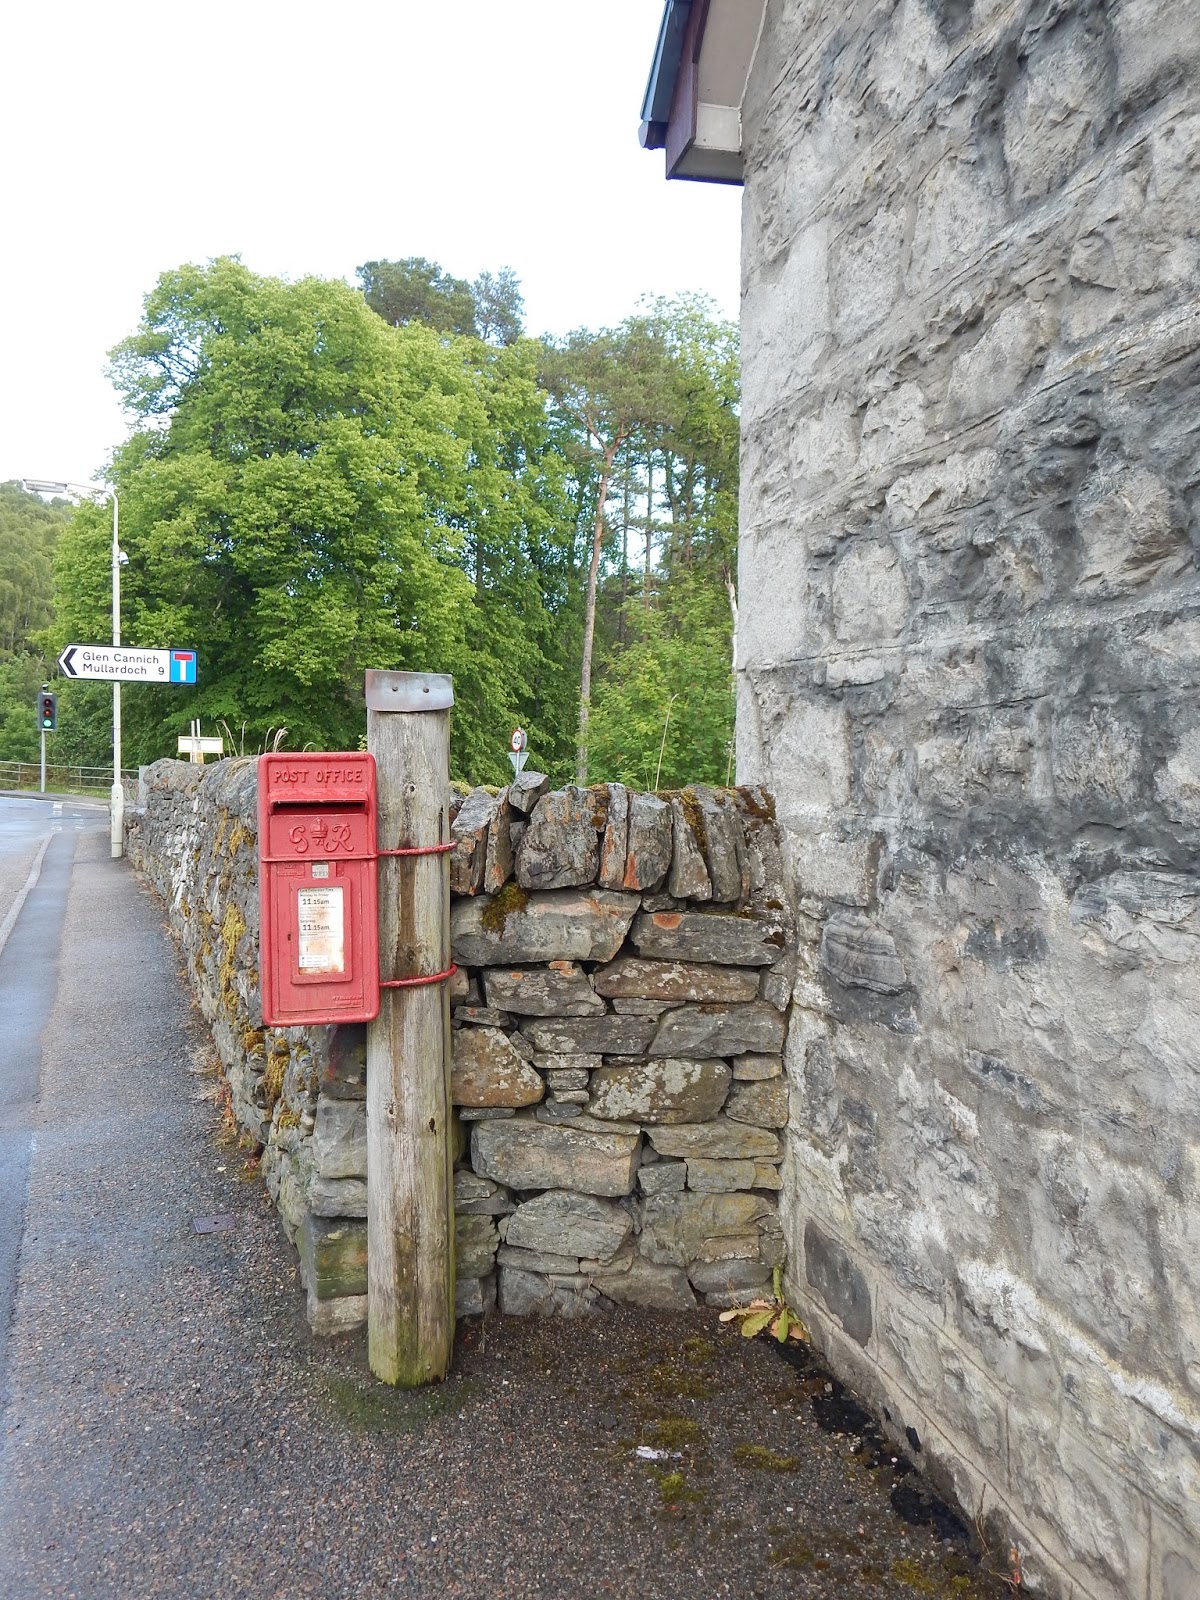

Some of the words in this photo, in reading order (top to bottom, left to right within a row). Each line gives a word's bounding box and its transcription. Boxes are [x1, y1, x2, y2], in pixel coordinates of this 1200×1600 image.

[82, 652, 109, 662] Glen
[113, 653, 159, 664] Cannich
[83, 663, 147, 675] Mullardoch
[158, 666, 165, 675] 9
[274, 770, 309, 783] POST
[315, 769, 363, 783] OFFICE
